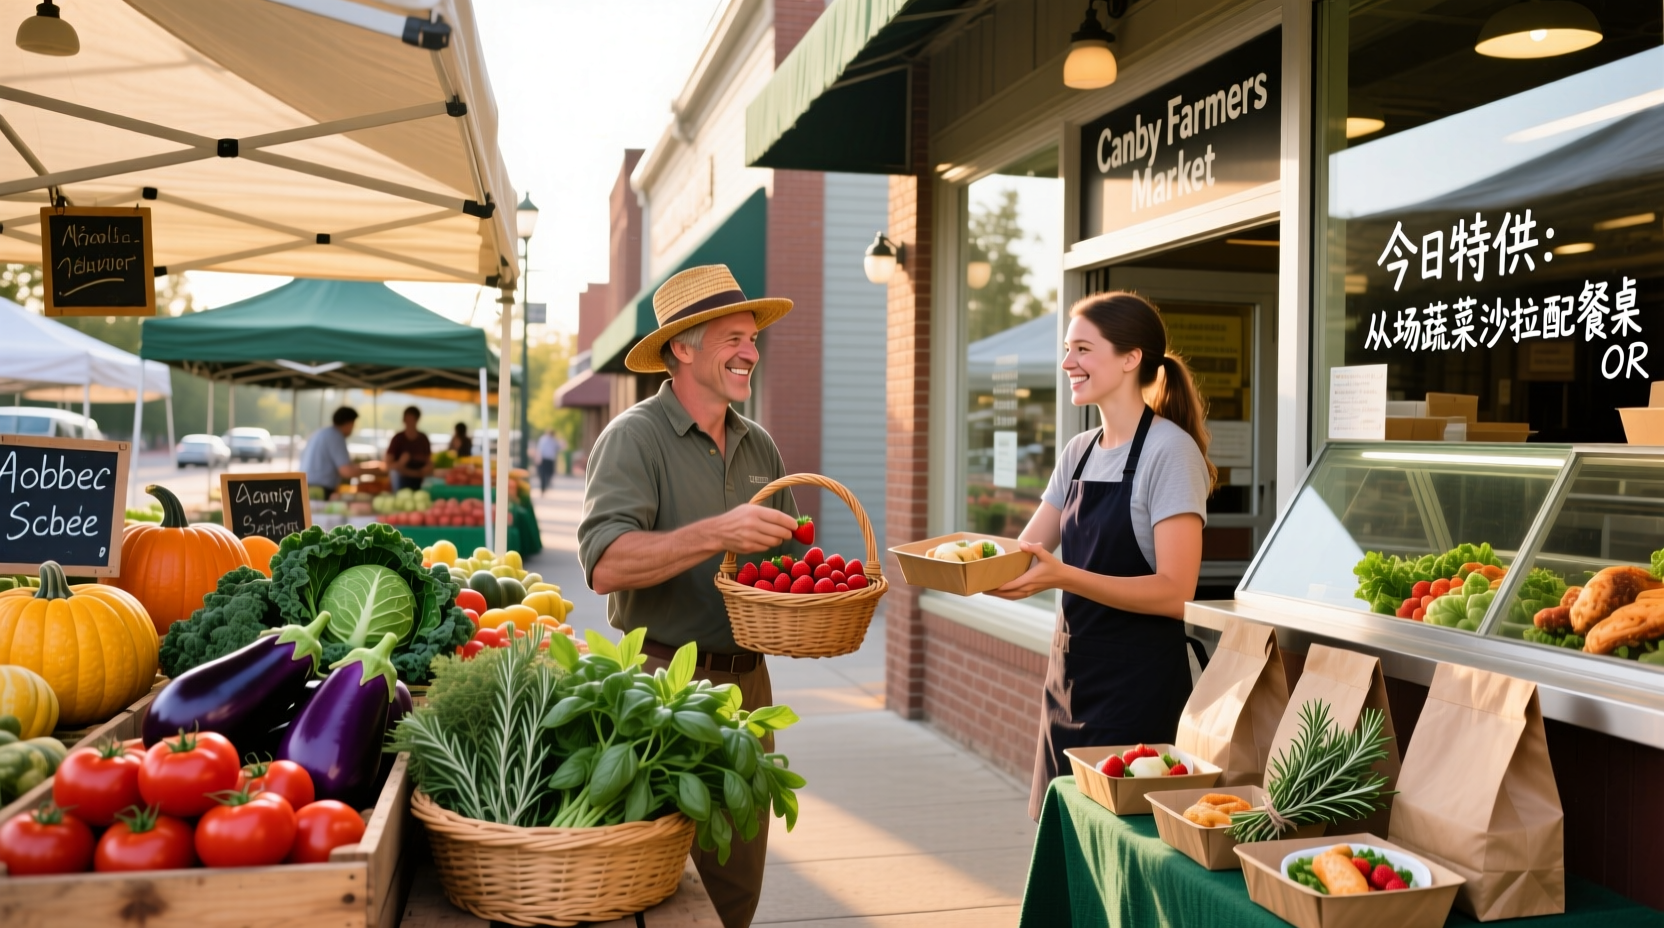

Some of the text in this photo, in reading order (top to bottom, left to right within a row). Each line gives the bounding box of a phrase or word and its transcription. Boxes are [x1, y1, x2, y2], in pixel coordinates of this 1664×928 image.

[1097, 72, 1267, 173] Canby Farmers
[1131, 144, 1216, 213] Market
[1364, 276, 1643, 352] 从场蔬菜沙拉配餐桌
[1601, 341, 1650, 380] OR
